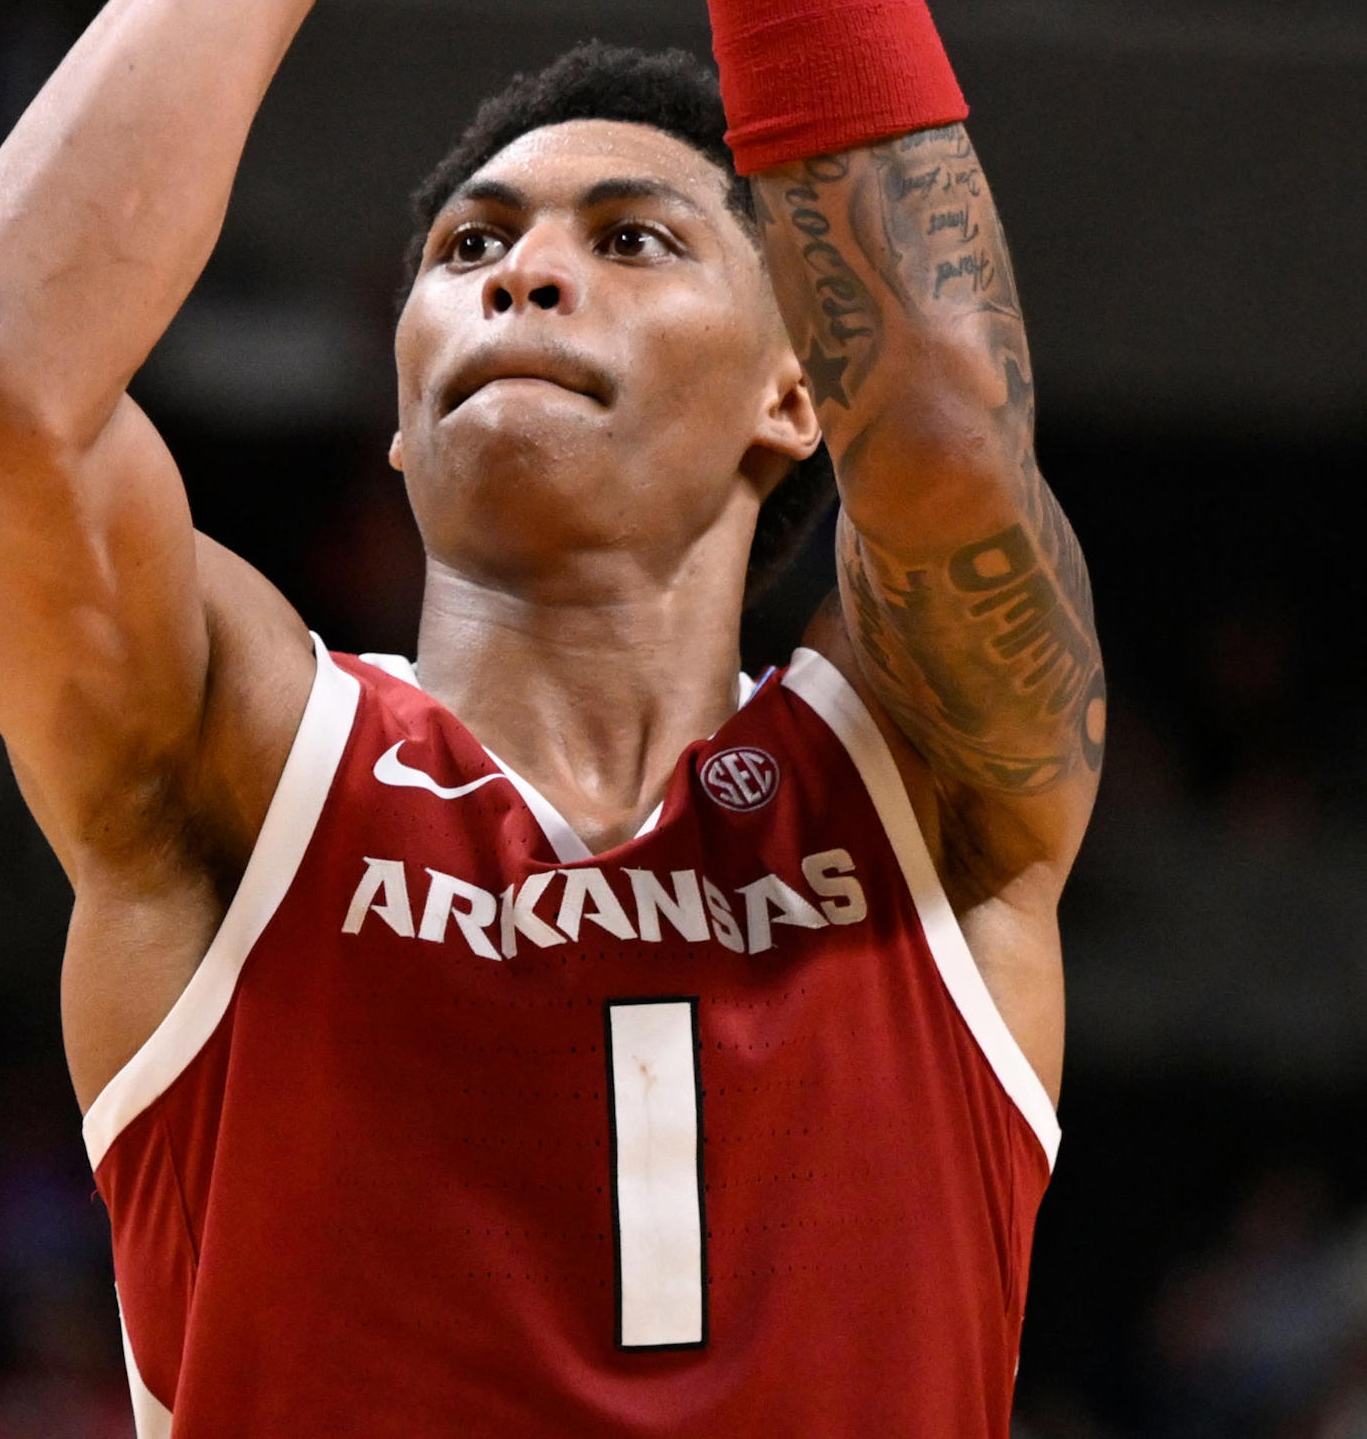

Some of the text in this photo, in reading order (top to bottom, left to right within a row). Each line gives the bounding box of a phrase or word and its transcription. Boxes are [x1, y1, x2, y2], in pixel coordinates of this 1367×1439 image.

[707, 750, 773, 806] SEC
[341, 847, 868, 961] ARKANSAS
[603, 995, 708, 1353] 1
